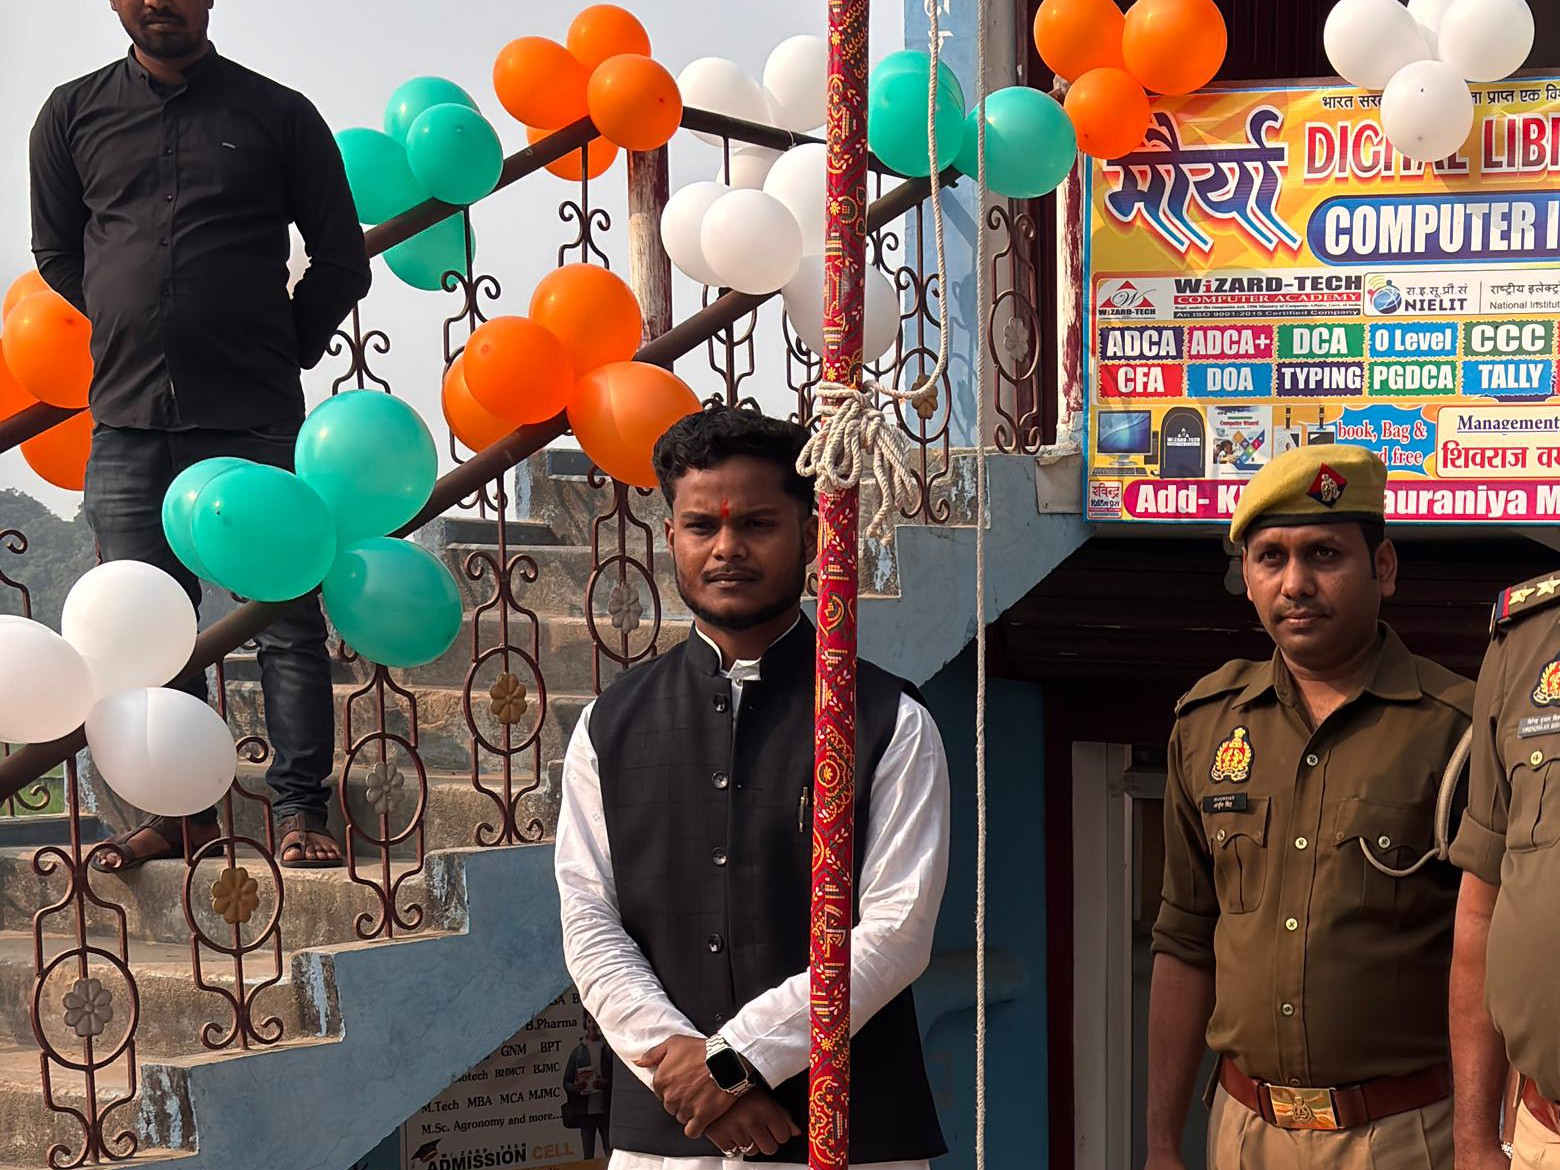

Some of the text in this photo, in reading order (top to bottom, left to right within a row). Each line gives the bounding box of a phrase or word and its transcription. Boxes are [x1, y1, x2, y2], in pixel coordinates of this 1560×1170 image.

[1323, 94, 1353, 109] भारत
[1487, 87, 1514, 104] प्राप्त
[1520, 86, 1540, 102] एक
[1324, 202, 1535, 254] COMPUTER
[1174, 275, 1362, 293] WiZARD-TECH
[1490, 283, 1525, 296] राष्ट्रीय
[1178, 293, 1359, 304] COMPUTER ACADEMY
[1404, 299, 1467, 312] NIELIT
[1490, 300, 1528, 310] National
[1107, 330, 1177, 357] ADCA
[1190, 330, 1271, 356] ADCA+
[1293, 327, 1348, 355] DCA
[1394, 327, 1452, 351] Level
[1471, 323, 1545, 352] CCC
[1117, 366, 1165, 394] CFA
[1207, 366, 1254, 392] DOA
[1281, 366, 1362, 390] TYPING
[1373, 365, 1454, 389] PGDCA
[1478, 363, 1545, 389] TALLY
[1337, 421, 1427, 442] book, Bag &
[1392, 448, 1422, 465] free
[1441, 440, 1529, 469] शिवराज
[1136, 484, 1209, 513] Add-
[501, 1040, 562, 1057] GNM BPT
[533, 1062, 560, 1074] BJMC
[421, 1087, 561, 1114] M.Tech MBA MCA MJMC
[422, 1121, 450, 1135] M.Sc.
[453, 1117, 505, 1133] Agronomy
[508, 1113, 526, 1126] and
[533, 1141, 575, 1160] CELL
